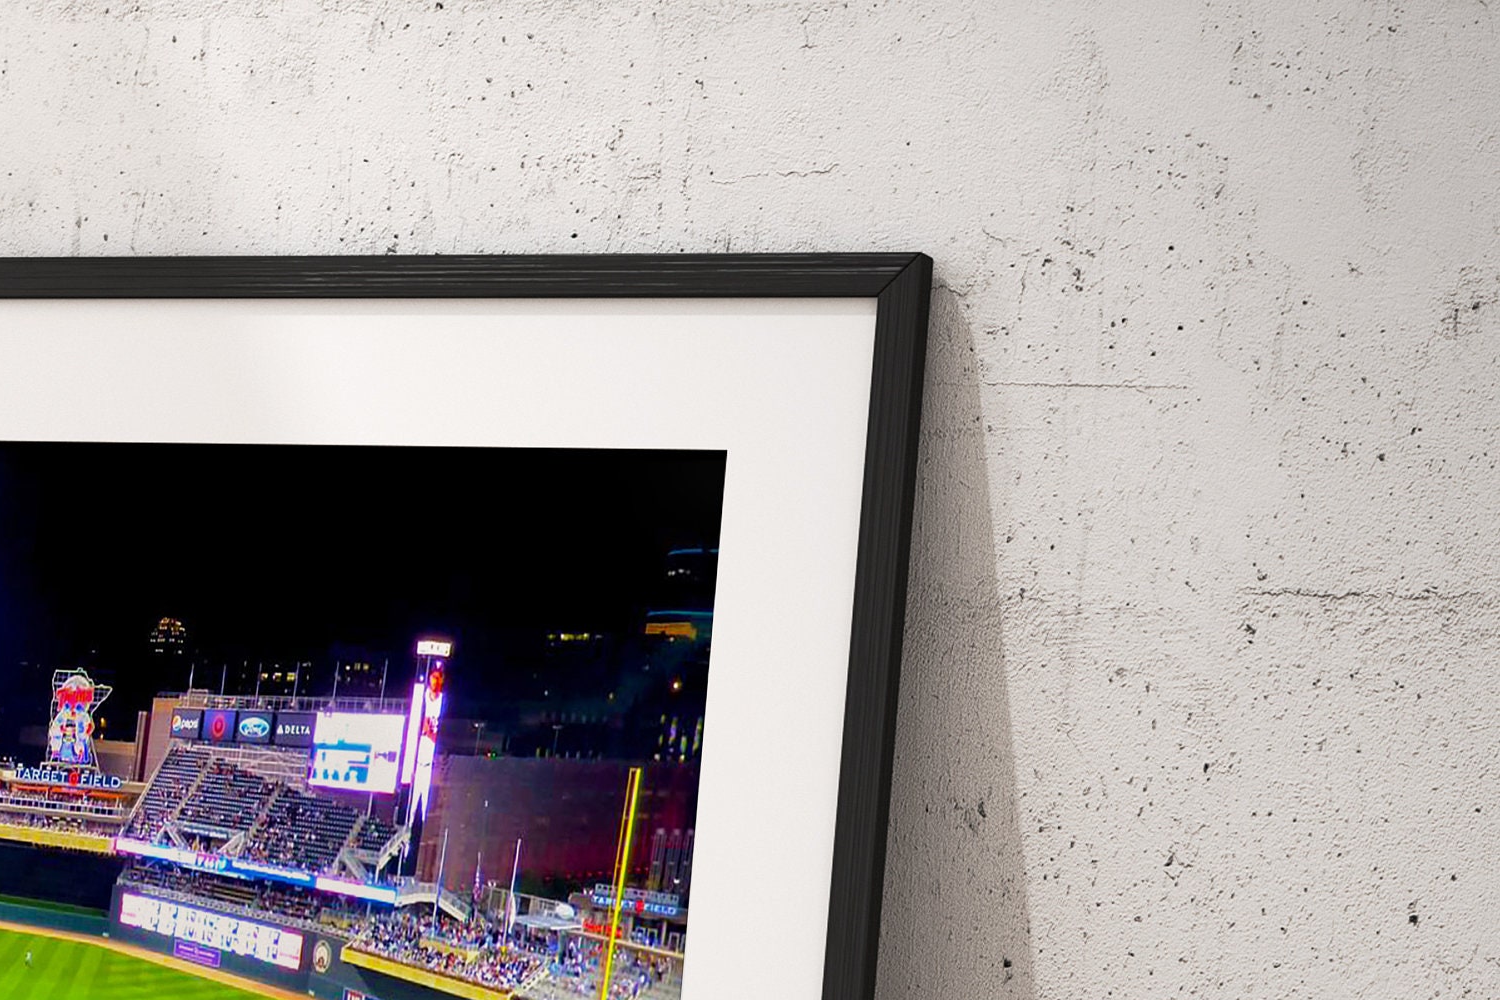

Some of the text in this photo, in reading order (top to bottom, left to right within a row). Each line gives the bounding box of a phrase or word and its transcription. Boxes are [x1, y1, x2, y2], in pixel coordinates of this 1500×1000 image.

[285, 725, 310, 735] DELTA
[16, 767, 121, 788] TARGET FIELD
[593, 895, 635, 908] TARET
